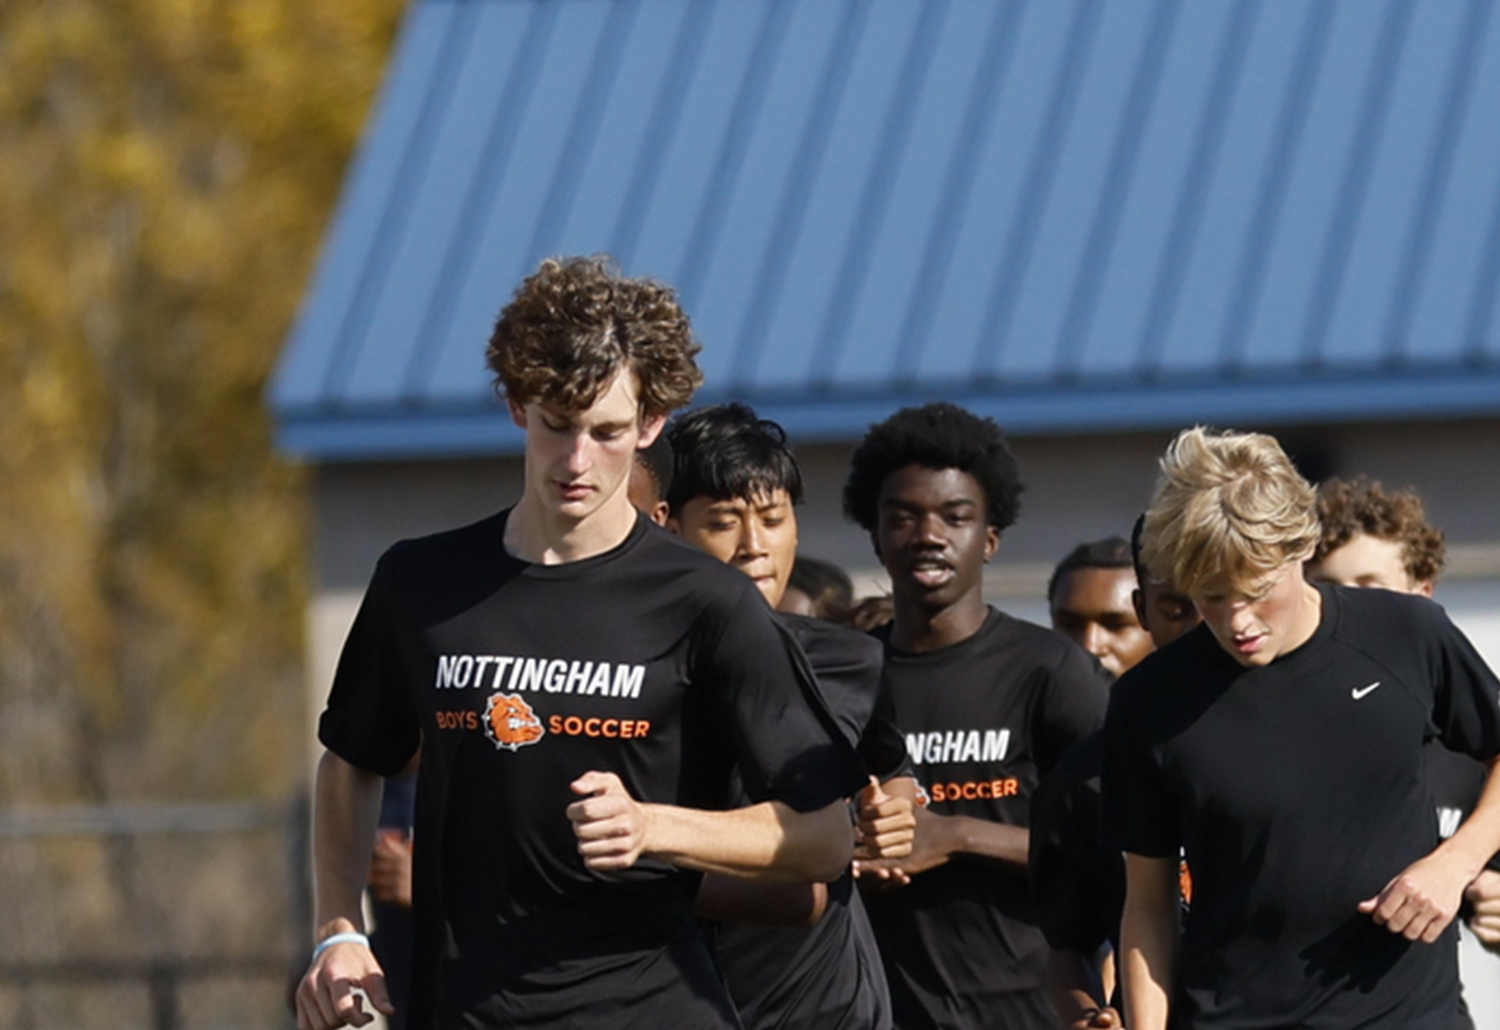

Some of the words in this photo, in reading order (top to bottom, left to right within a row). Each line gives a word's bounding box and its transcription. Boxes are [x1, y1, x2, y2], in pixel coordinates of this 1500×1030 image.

[435, 655, 646, 699] NOTTINGHAM
[435, 711, 479, 729] BOYS
[549, 715, 650, 739] SOCCER
[931, 778, 1019, 802] SOCCER
